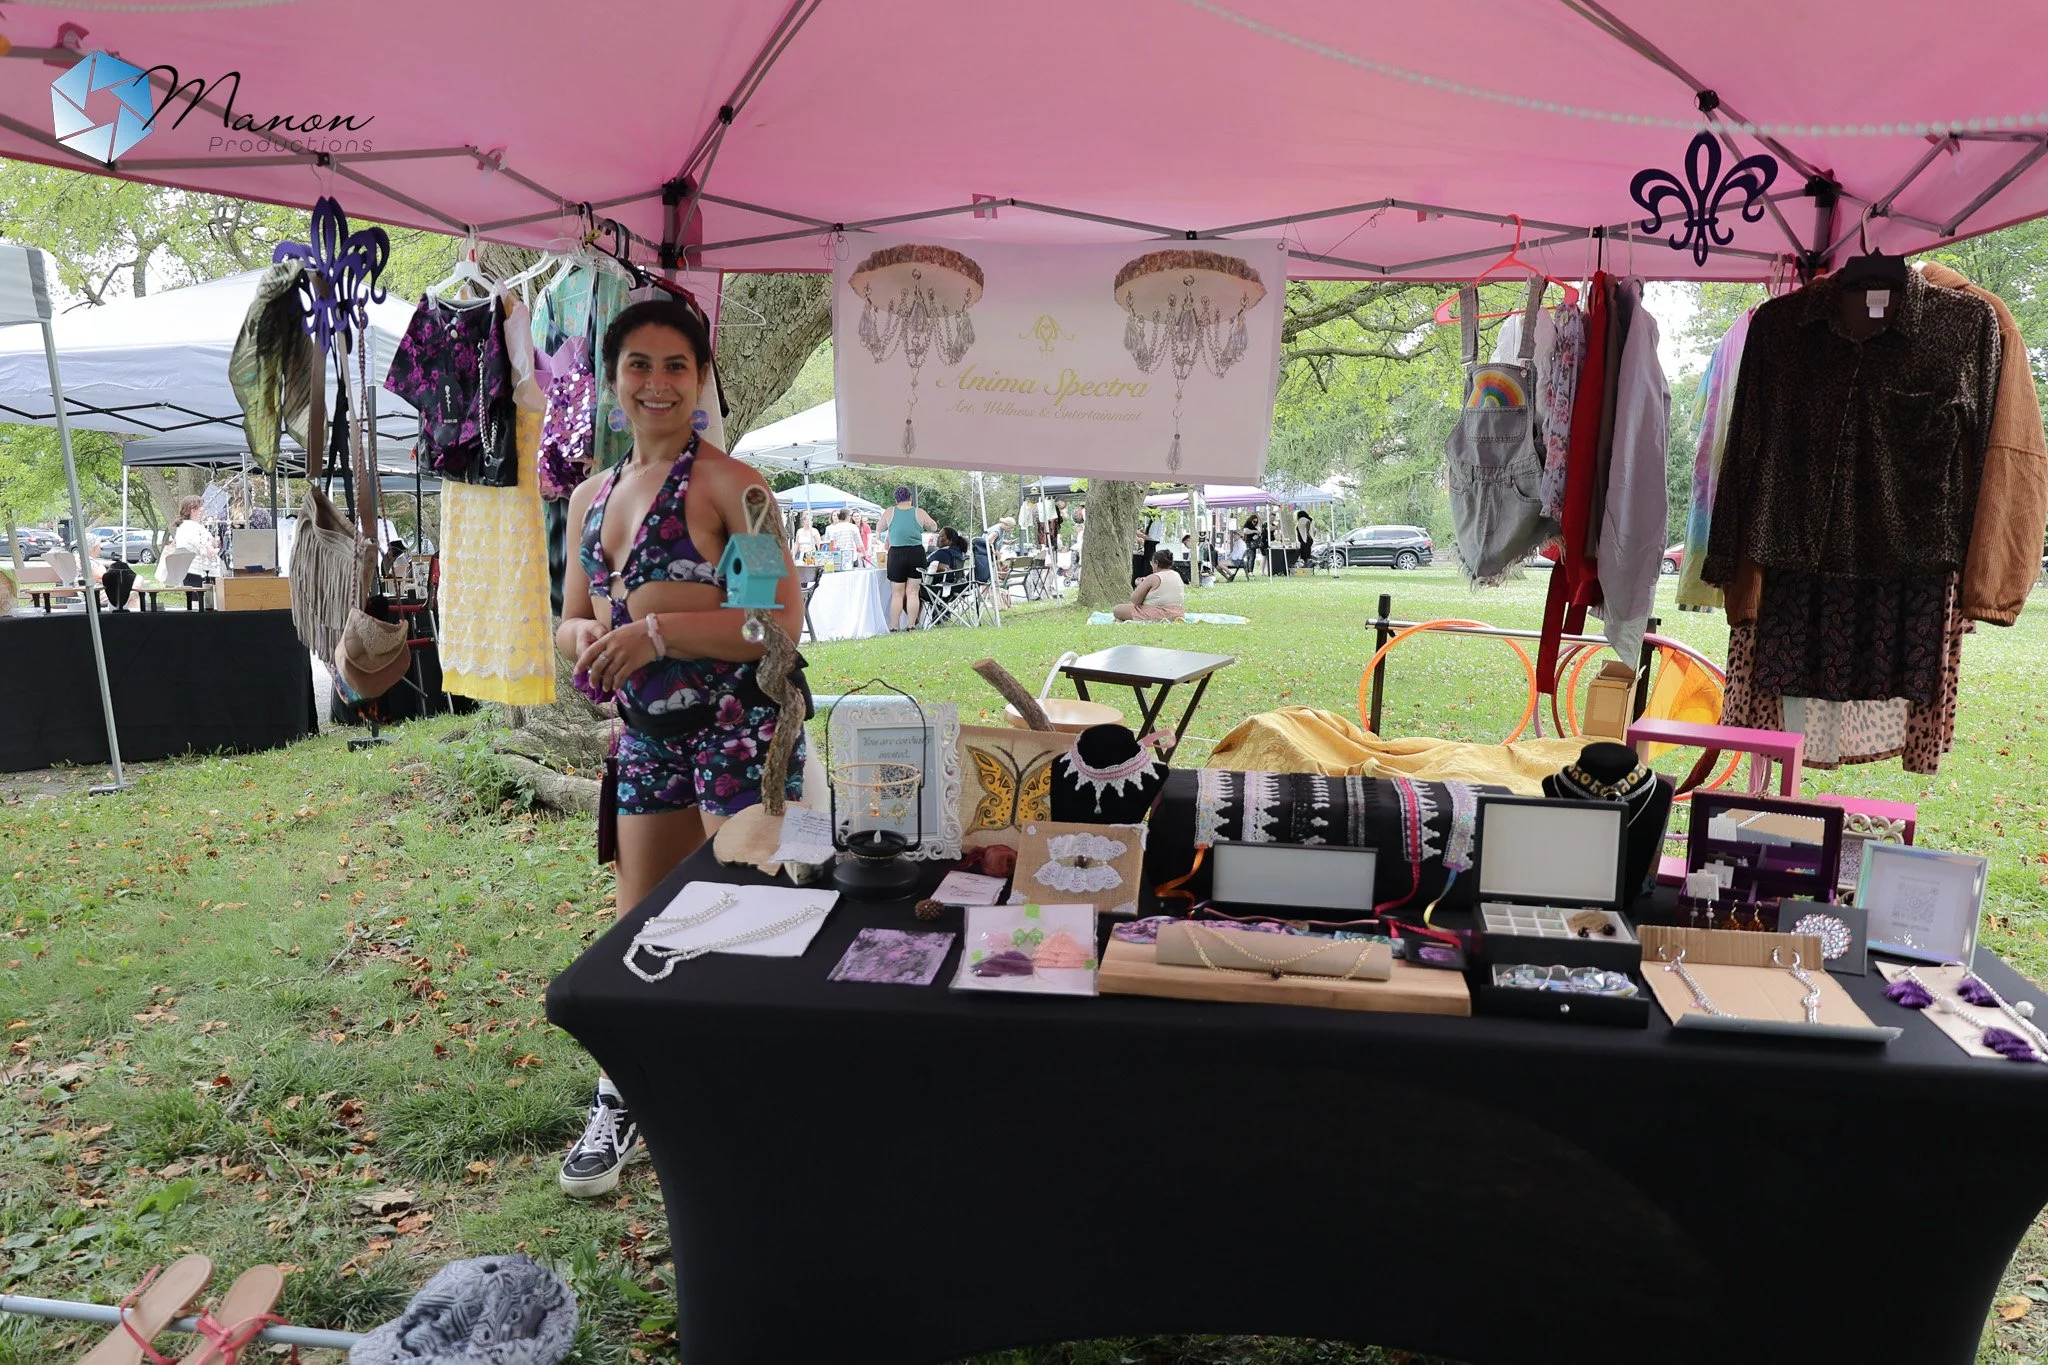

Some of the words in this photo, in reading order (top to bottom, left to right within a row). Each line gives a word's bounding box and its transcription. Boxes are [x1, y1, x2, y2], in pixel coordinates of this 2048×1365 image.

[935, 362, 1040, 395] Anima
[1043, 367, 1151, 407] Spectra
[983, 401, 1036, 418] Wellness
[1054, 403, 1143, 422] Entertainment
